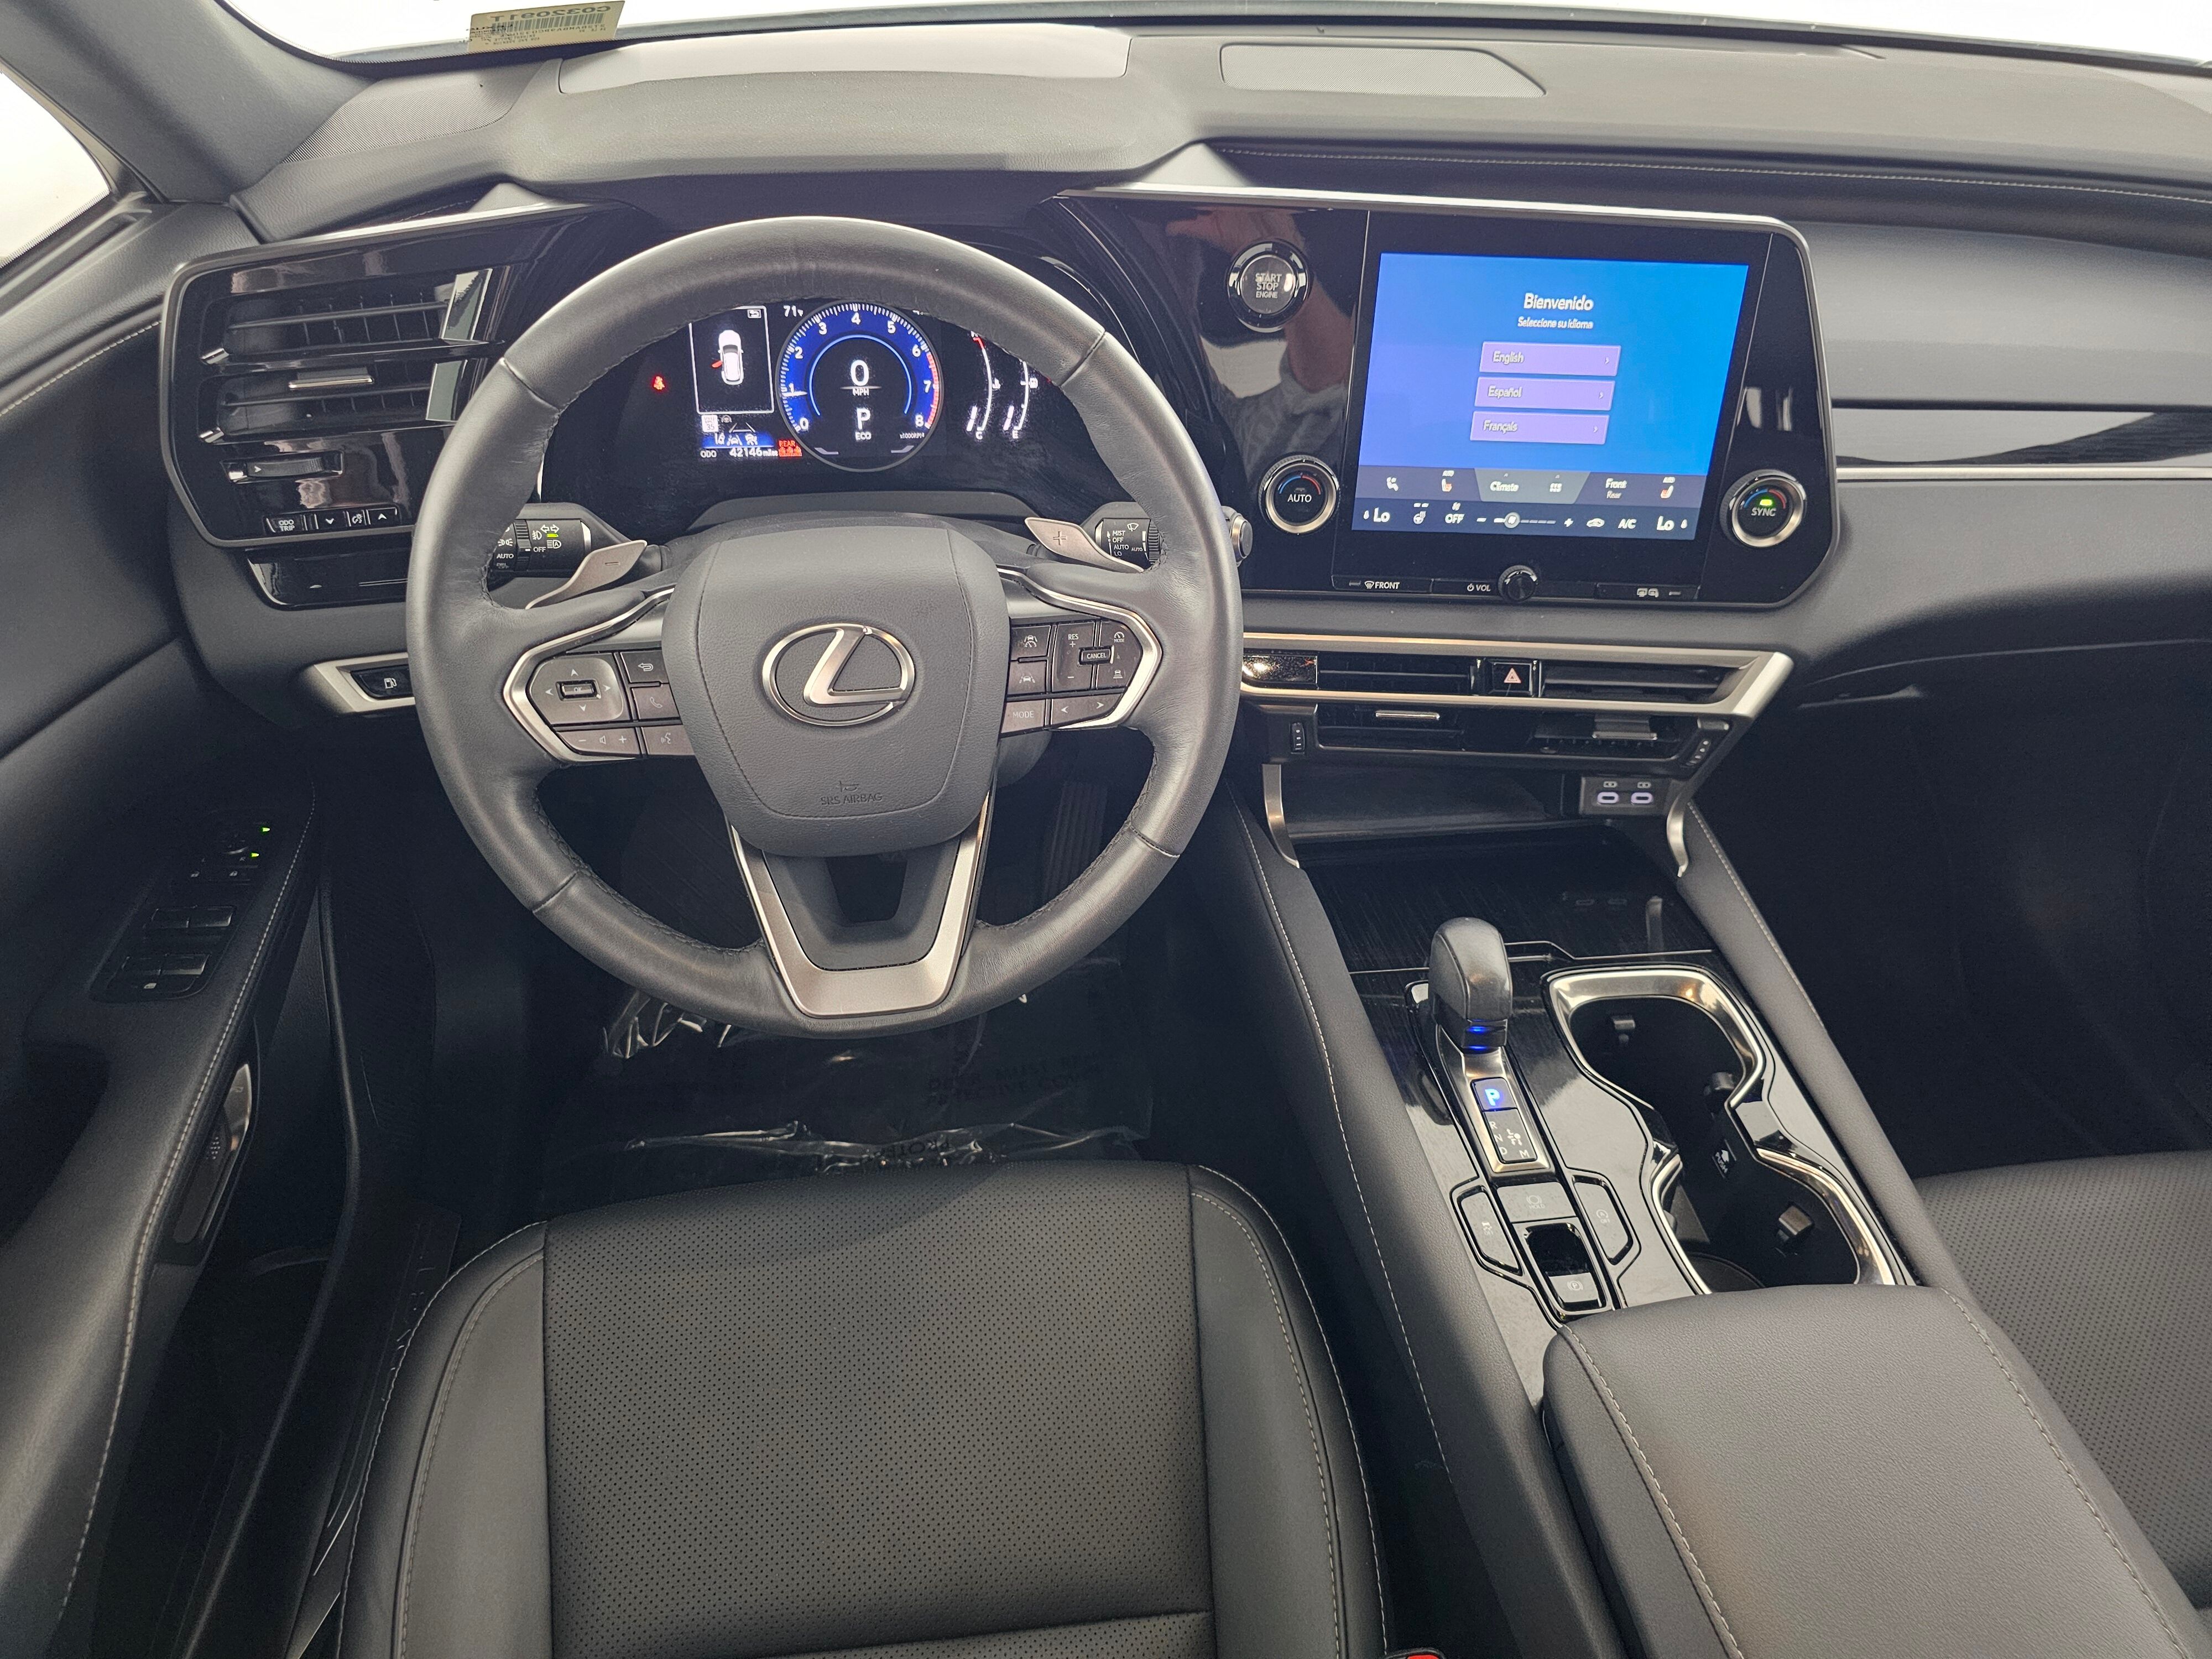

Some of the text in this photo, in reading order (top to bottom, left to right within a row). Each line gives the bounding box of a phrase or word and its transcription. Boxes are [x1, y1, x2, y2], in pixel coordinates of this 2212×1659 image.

[1255, 273, 1282, 283] START
[1524, 292, 1594, 311] Bienvenido
[851, 312, 861, 325] 4
[1517, 316, 1594, 329] Seleccione su idioma
[818, 322, 827, 335] 3
[887, 321, 896, 334] 5
[795, 346, 804, 359] 2
[912, 345, 921, 357] 6
[1493, 351, 1524, 364] English
[851, 359, 870, 386] 0
[789, 383, 795, 396] 1
[924, 380, 932, 393] 7
[1488, 385, 1523, 399] Español
[800, 418, 809, 430] 0
[857, 408, 870, 430] P
[915, 415, 924, 427] 8
[1483, 420, 1518, 434] Français
[855, 432, 872, 440] ECO
[1012, 430, 1019, 439] E
[729, 447, 763, 457] 42146
[763, 448, 779, 457] miles
[1490, 481, 1520, 492] Climate
[1605, 478, 1627, 489] Front
[1287, 494, 1312, 503] AUTO
[1606, 491, 1623, 499] Rear
[1373, 507, 1391, 523] Lo
[1751, 507, 1776, 517] SYNC
[1444, 513, 1465, 524] OFF
[1618, 518, 1637, 529] A/C
[1656, 515, 1674, 531] Lo
[1375, 581, 1400, 589] FRONT
[1475, 584, 1491, 592] VOL
[1013, 711, 1035, 719] MODE
[821, 792, 883, 805] SRS AIRBAG
[1485, 1088, 1500, 1106] P
[1489, 1121, 1498, 1129] R
[1493, 1134, 1504, 1142] N
[1499, 1147, 1507, 1155] D
[1519, 1149, 1530, 1159] M
